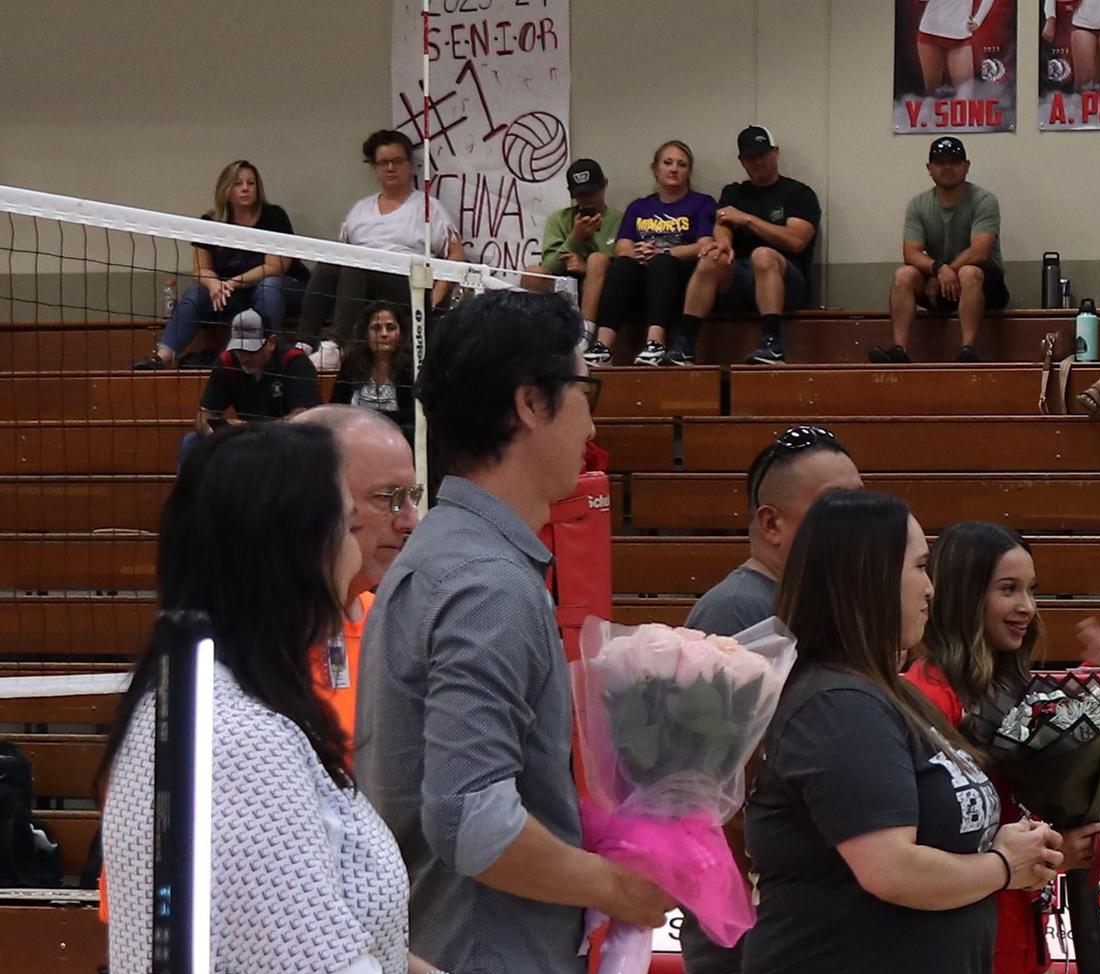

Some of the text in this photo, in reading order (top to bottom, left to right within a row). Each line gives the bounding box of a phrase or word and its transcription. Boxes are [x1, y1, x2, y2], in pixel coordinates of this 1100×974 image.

[905, 98, 1003, 127] Y. SONG
[1049, 91, 1075, 125] A.
